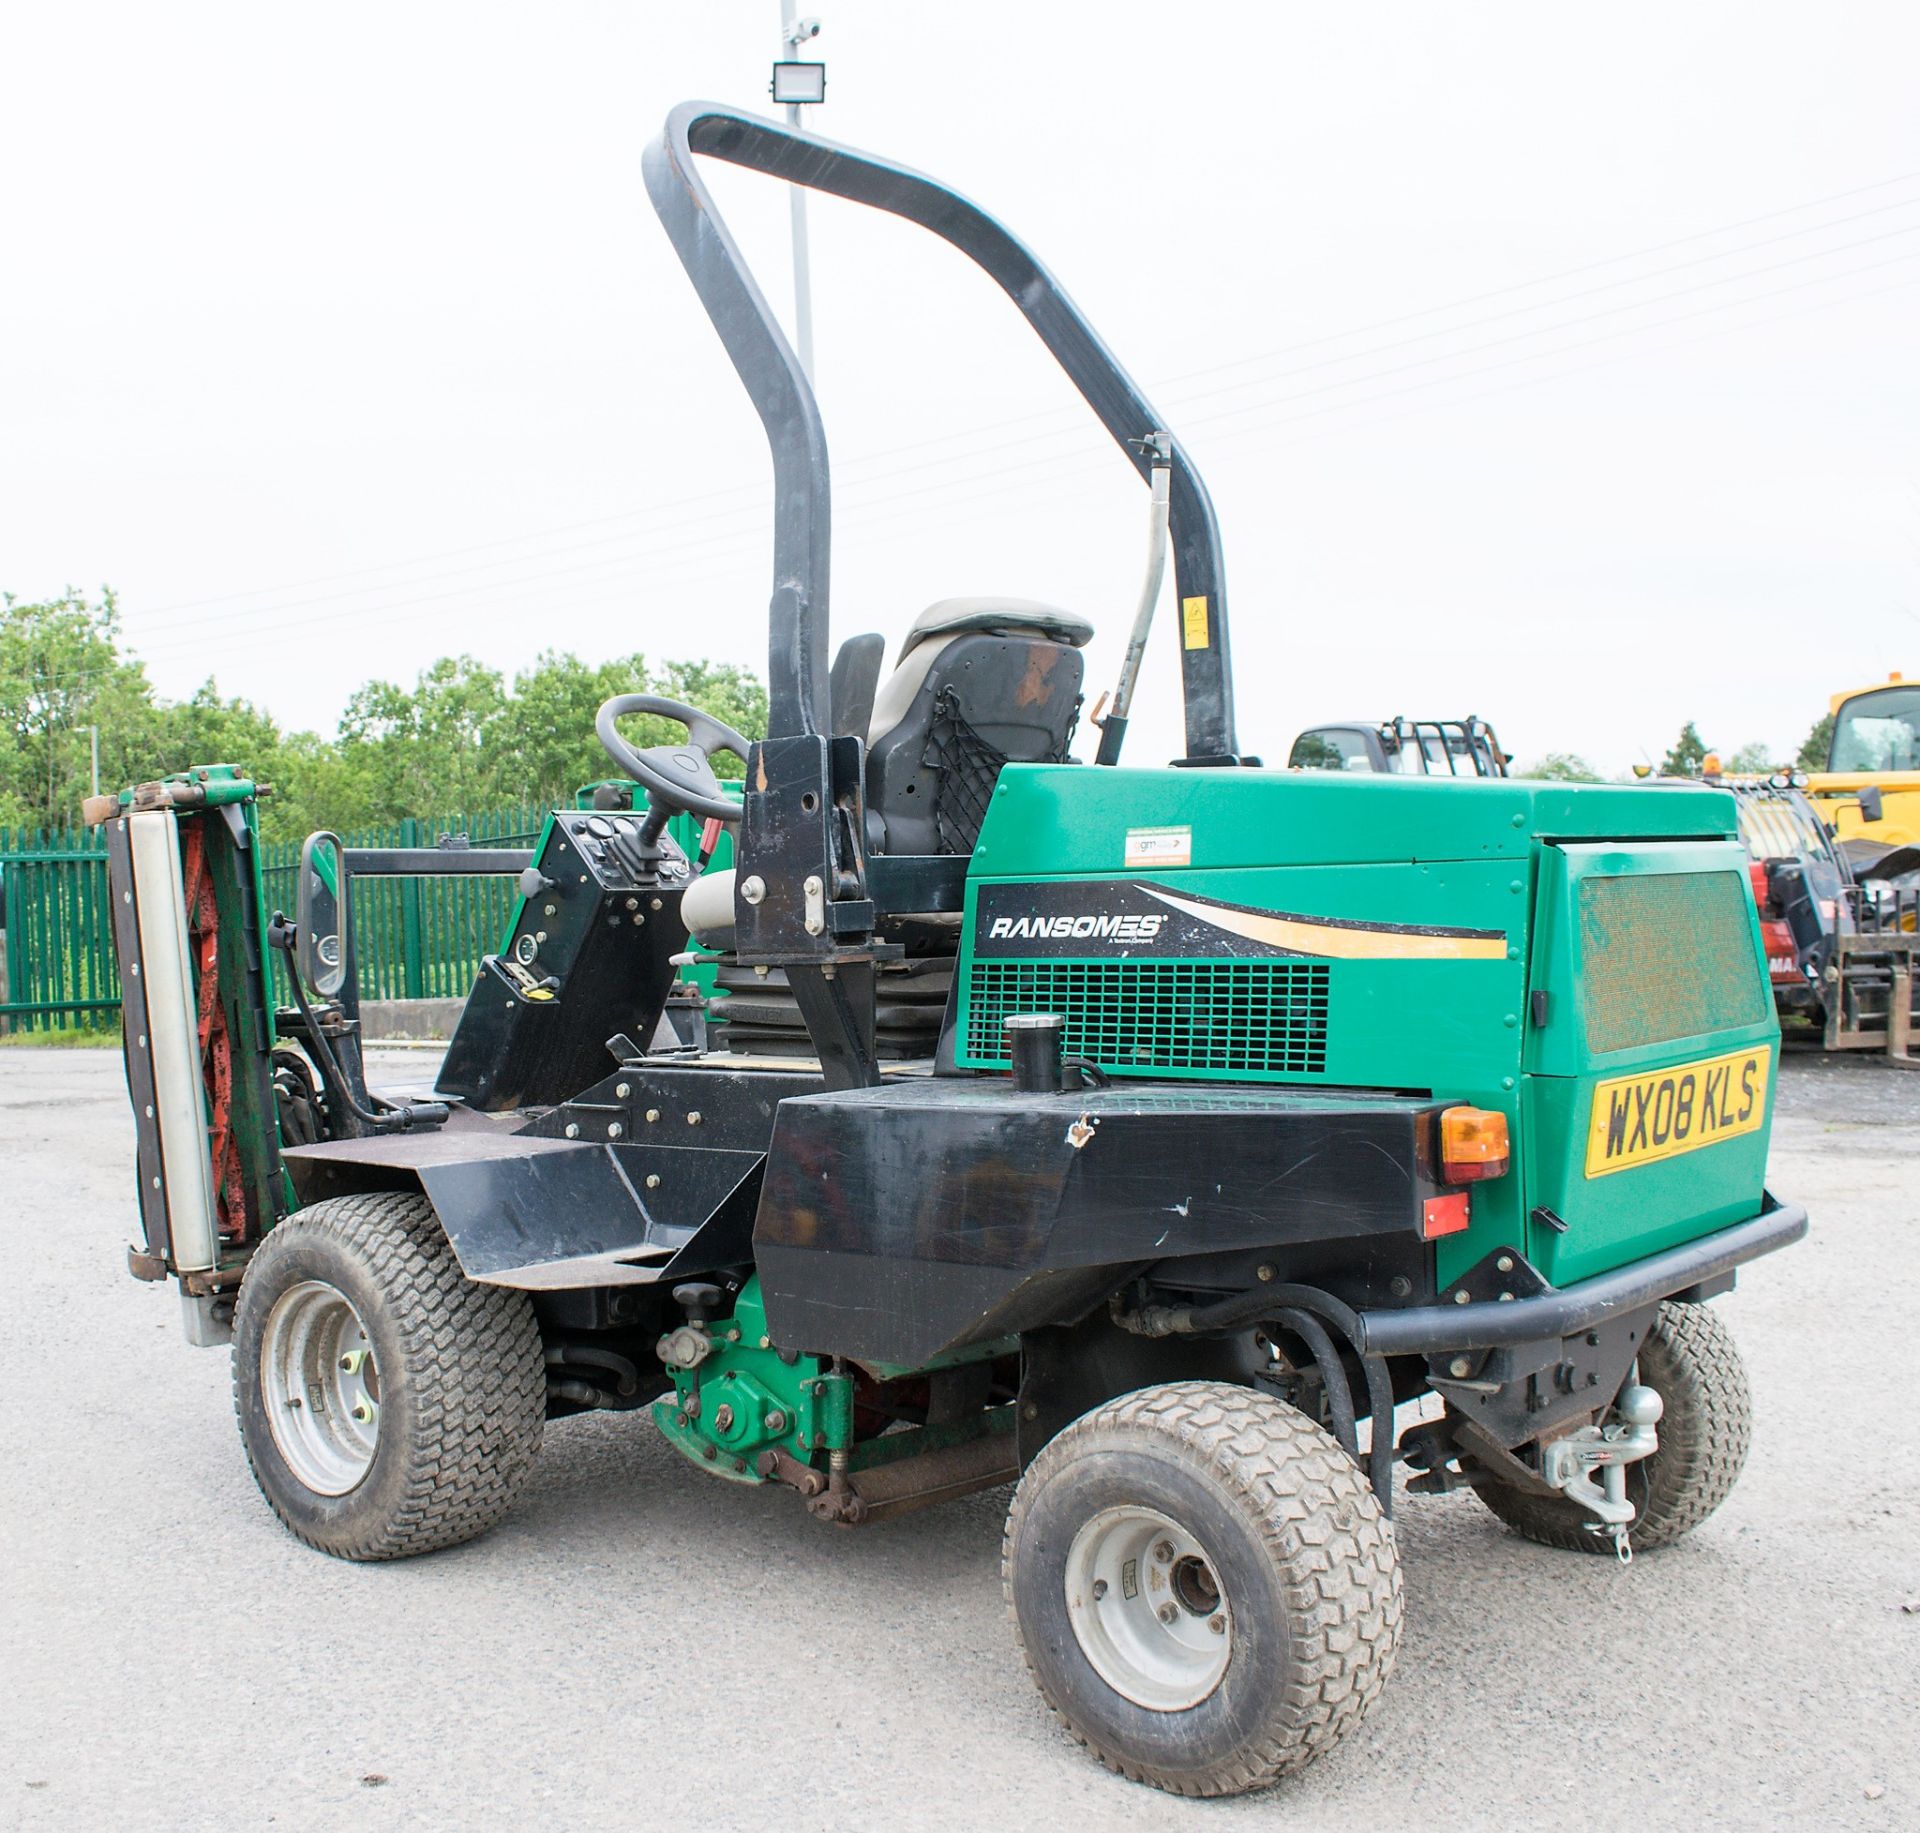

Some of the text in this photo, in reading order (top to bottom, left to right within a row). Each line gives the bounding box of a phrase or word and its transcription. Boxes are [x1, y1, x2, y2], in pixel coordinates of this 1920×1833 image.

[988, 914, 1163, 939] RANSOMES
[1606, 1059, 1757, 1159] WX08 KLS
